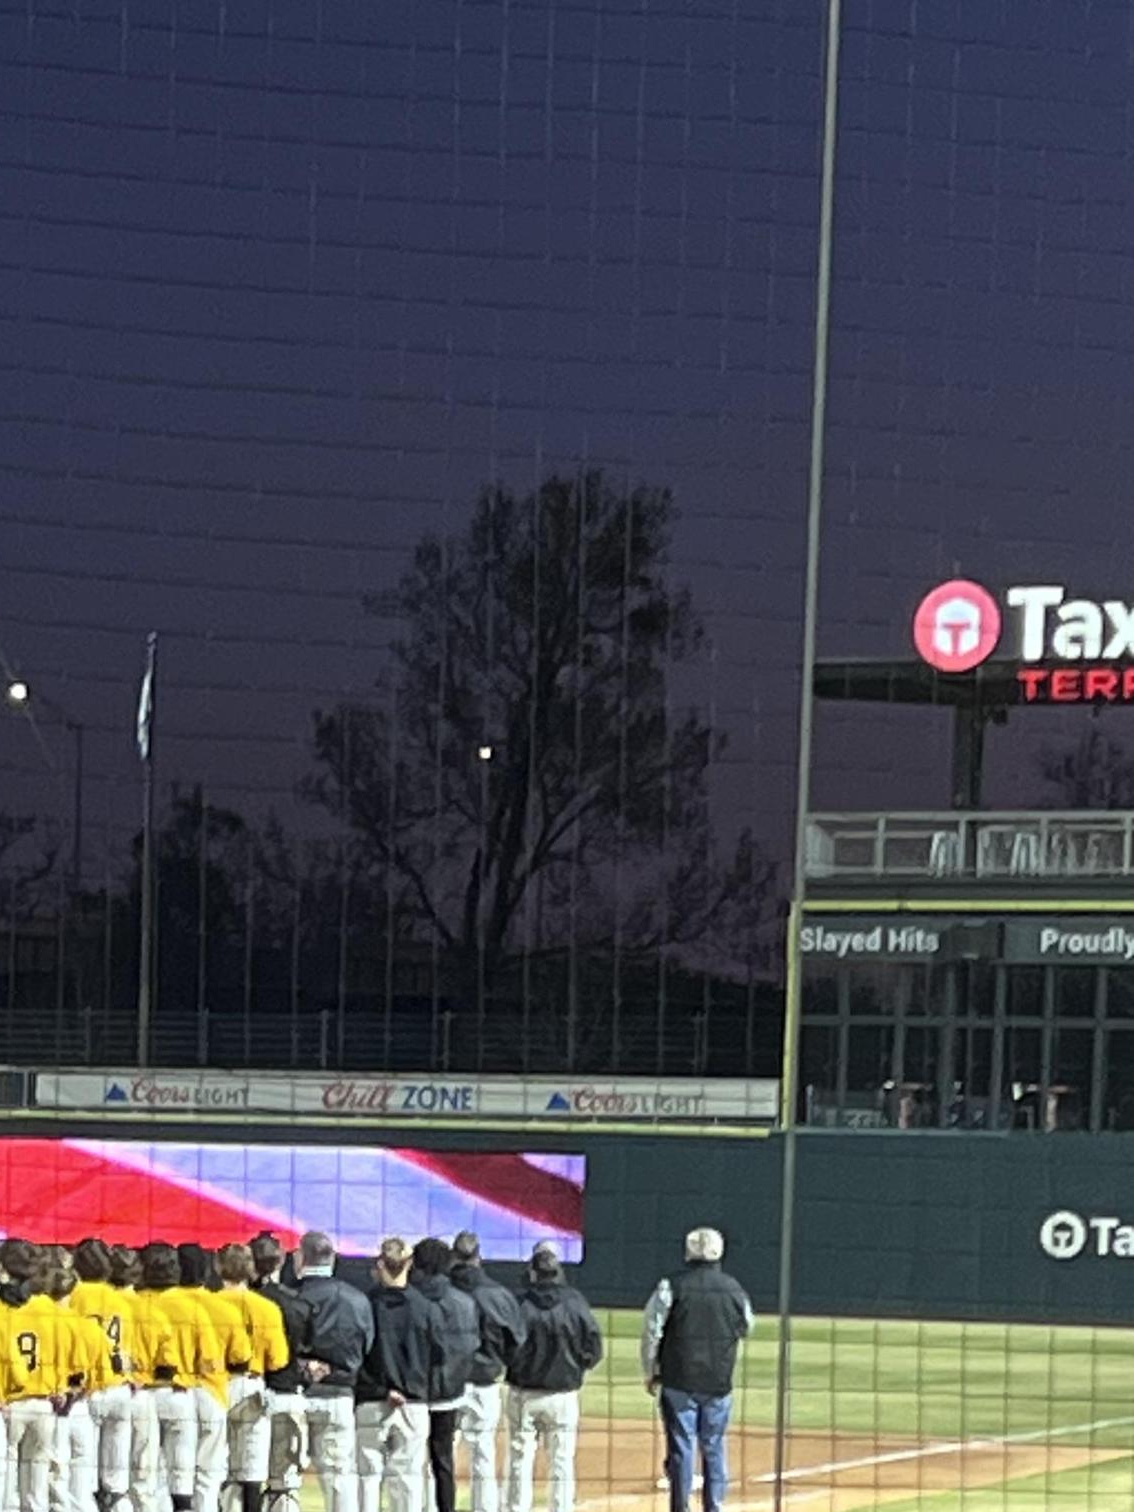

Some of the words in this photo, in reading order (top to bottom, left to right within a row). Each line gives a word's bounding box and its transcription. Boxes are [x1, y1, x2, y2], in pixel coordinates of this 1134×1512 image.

[800, 926, 882, 958] Slayed
[887, 926, 940, 952] Hits
[1040, 928, 1134, 959] Proudly
[401, 1084, 472, 1111] ZONE
